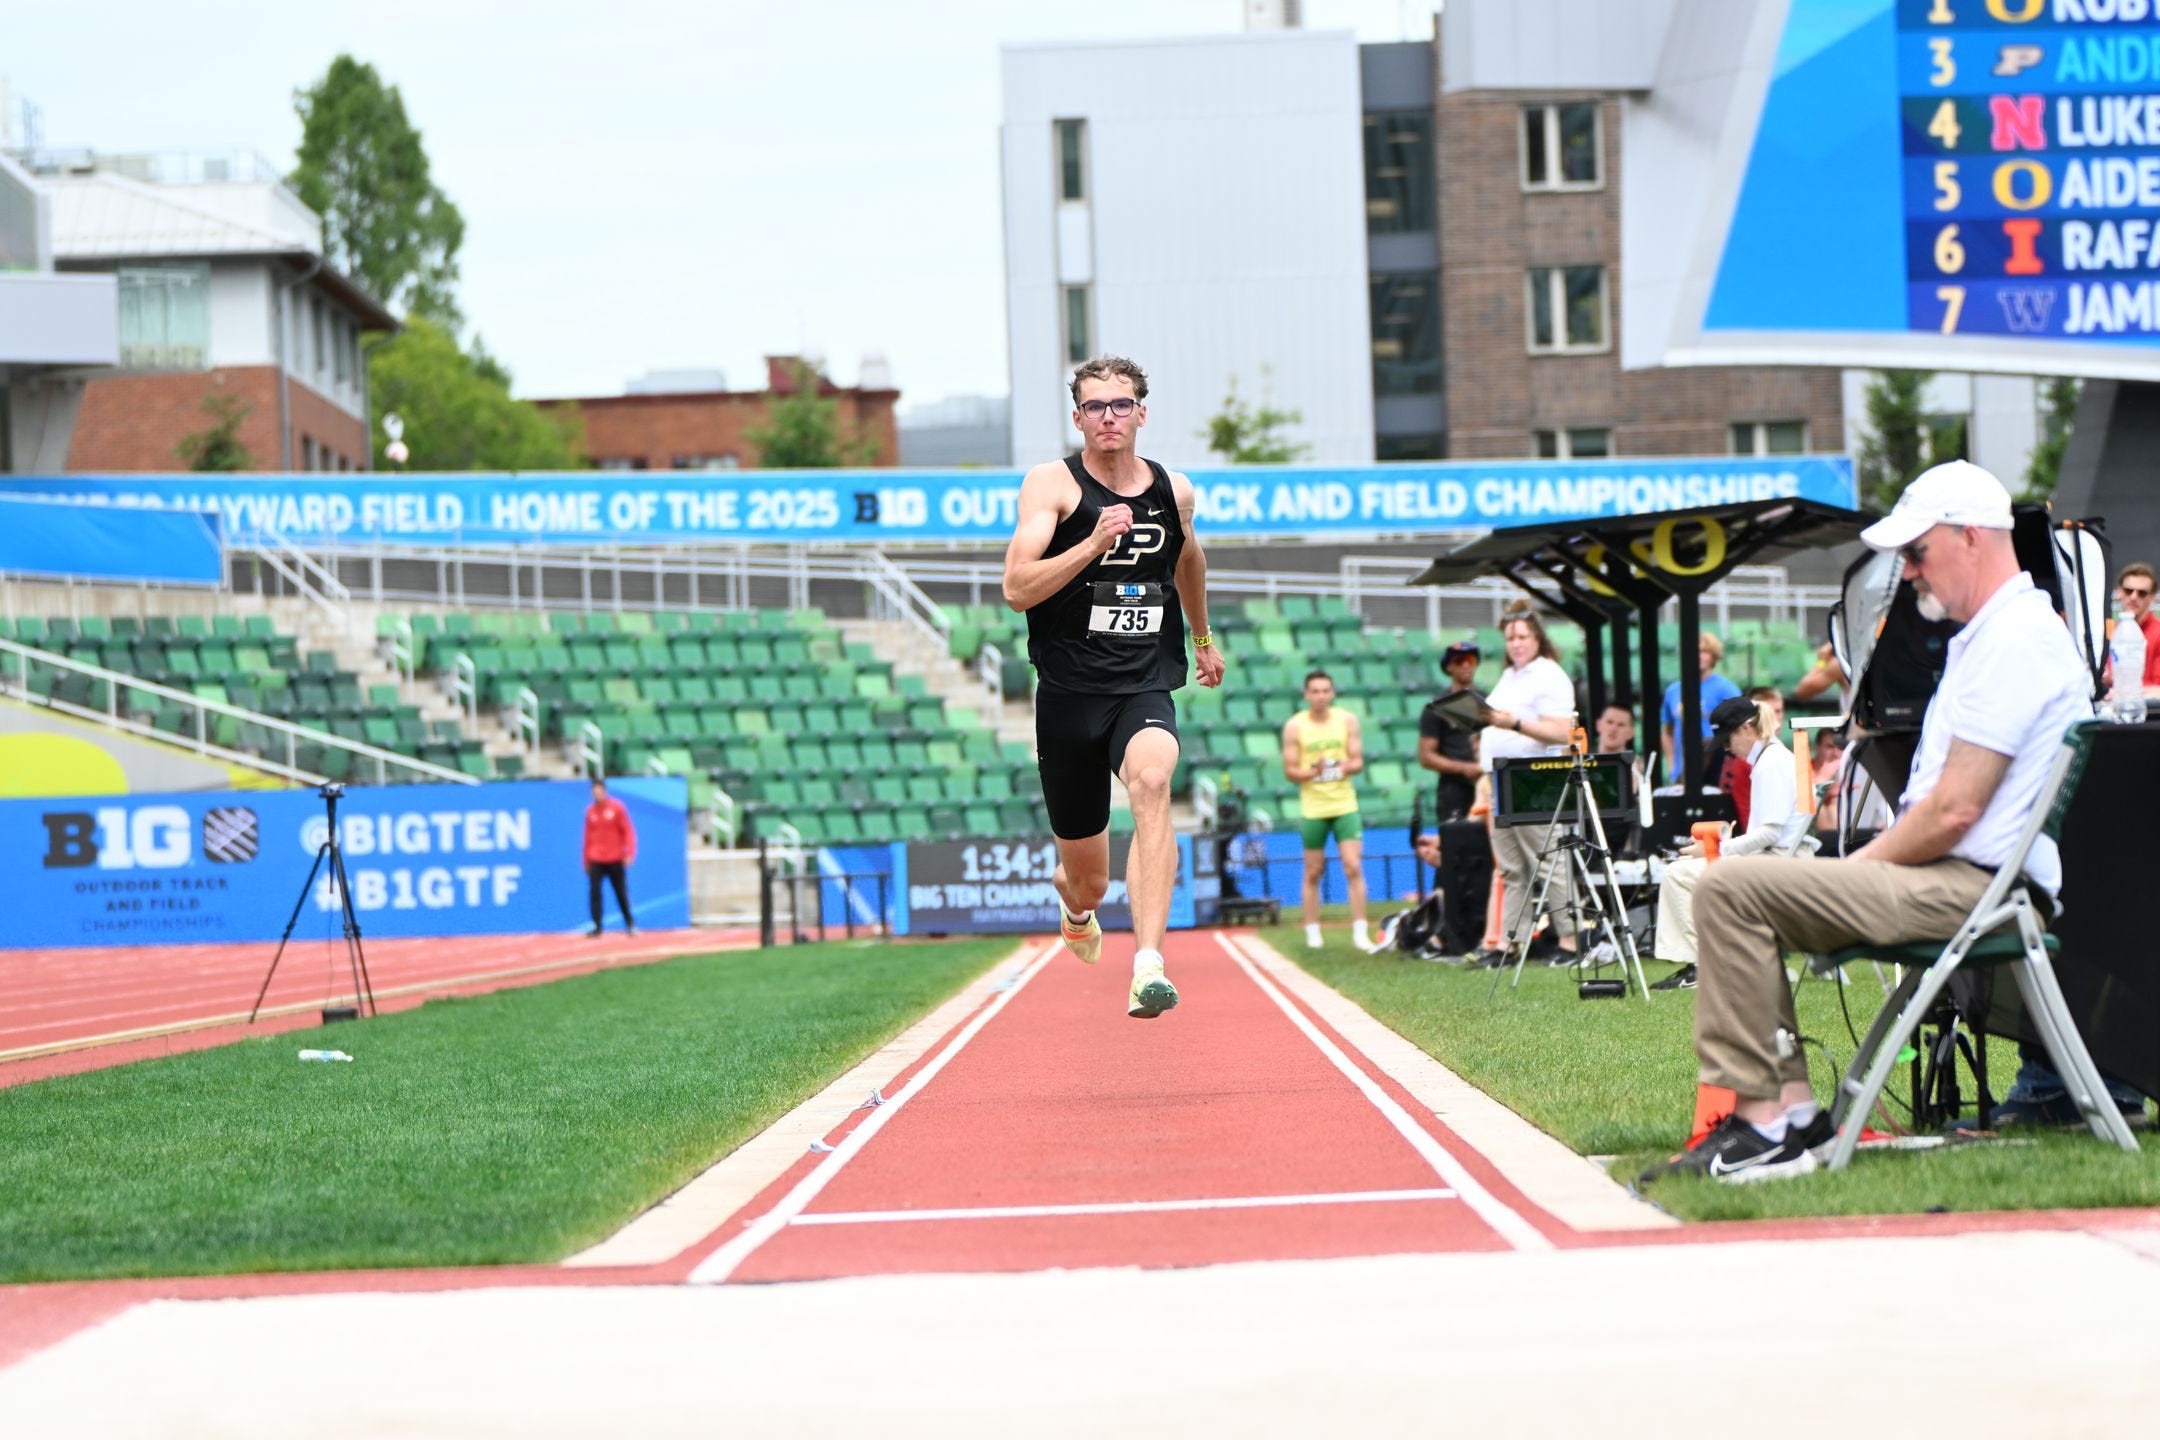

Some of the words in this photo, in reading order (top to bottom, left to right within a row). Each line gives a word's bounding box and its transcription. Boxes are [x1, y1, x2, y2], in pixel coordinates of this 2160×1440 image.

[1928, 36, 1956, 87] 3
[1992, 45, 2043, 76] P
[1928, 98, 1962, 149] 4
[1989, 94, 2046, 150] N
[2057, 96, 2160, 147] LUKE
[1933, 161, 1961, 211] 5
[1992, 159, 2052, 210] O
[2059, 158, 2160, 208] AIDE
[1934, 223, 1965, 274] 6
[2003, 218, 2044, 274] I
[1936, 285, 1966, 335] 7
[361, 492, 464, 533] FIELD
[490, 491, 603, 531] HOME
[608, 491, 658, 530] OF
[664, 491, 742, 529] THE
[747, 489, 840, 529] 2025
[1269, 481, 1353, 521] AND
[1359, 479, 1469, 519] FIELD
[1100, 523, 1166, 566] P
[1653, 516, 1727, 577] O
[1108, 609, 1149, 632] 735
[106, 900, 142, 912] AND
[150, 898, 200, 910] FIELD
[910, 885, 943, 909] BIG
[944, 884, 982, 908] TEN
